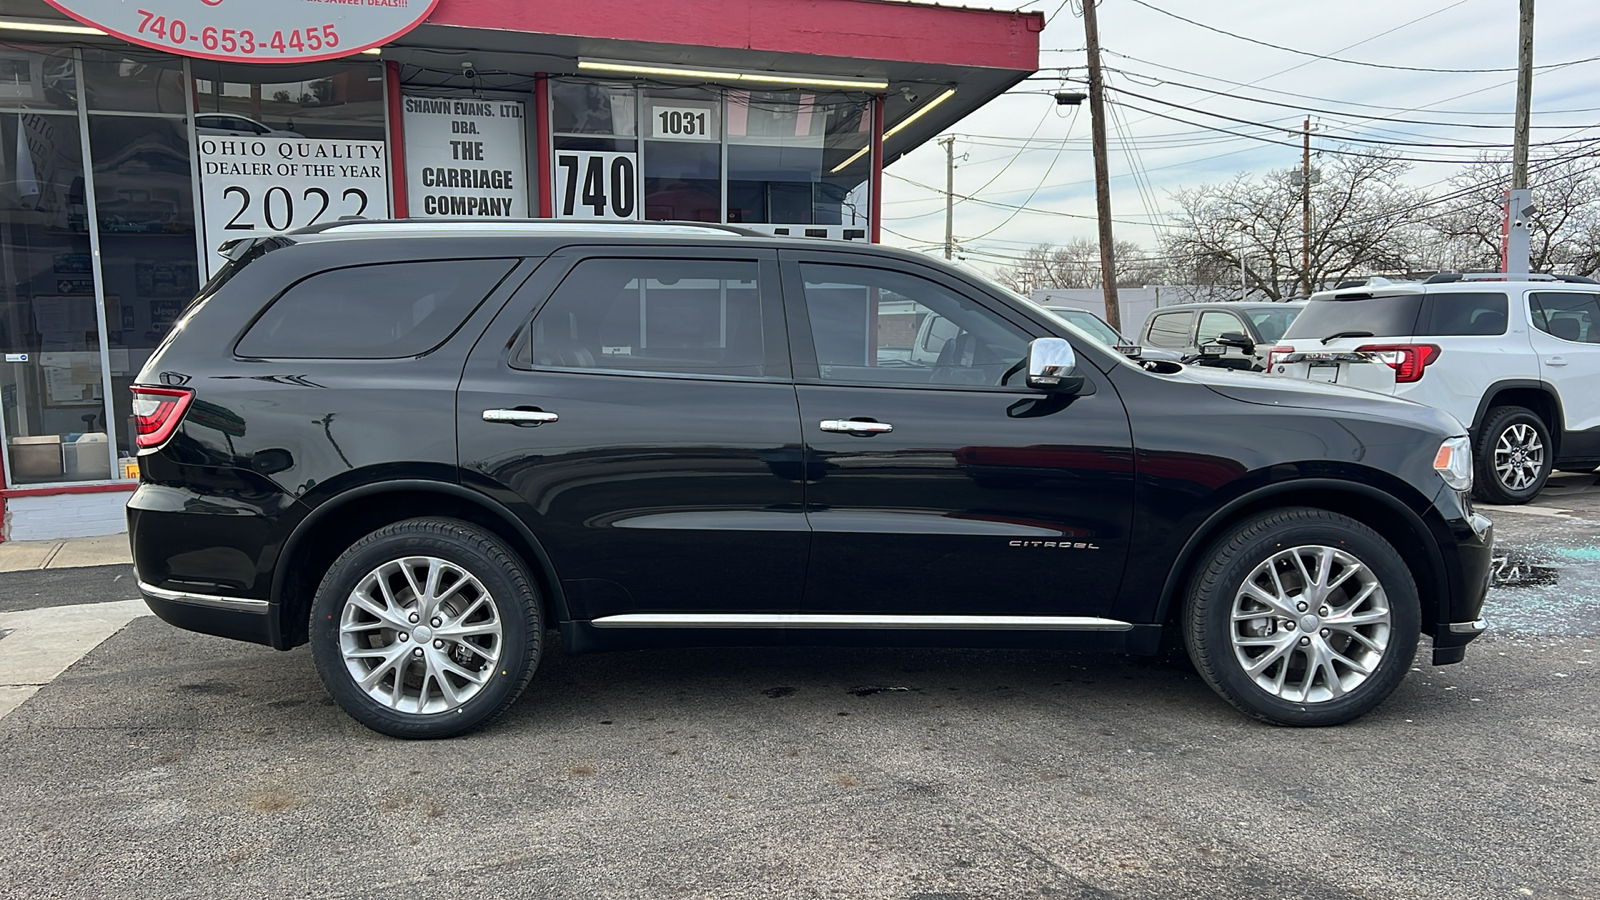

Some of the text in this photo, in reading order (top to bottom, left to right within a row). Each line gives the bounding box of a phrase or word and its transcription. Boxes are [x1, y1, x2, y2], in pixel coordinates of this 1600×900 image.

[367, 0, 408, 8] DEALS!!!
[137, 9, 339, 54] 740-653-4455
[405, 99, 523, 119] SHAWN EVANS. LTD.
[451, 120, 480, 135] DBA.
[658, 111, 706, 135] 1031
[201, 140, 383, 161] OHIO QUALITY
[449, 140, 484, 161] THE
[204, 161, 382, 179] DEALER OF THE YEAR
[422, 167, 514, 190] CARRIAGE
[558, 155, 635, 218] 740
[222, 185, 369, 232] 2022
[424, 195, 513, 217] COMPANY
[1008, 540, 1100, 550] CITADEL
